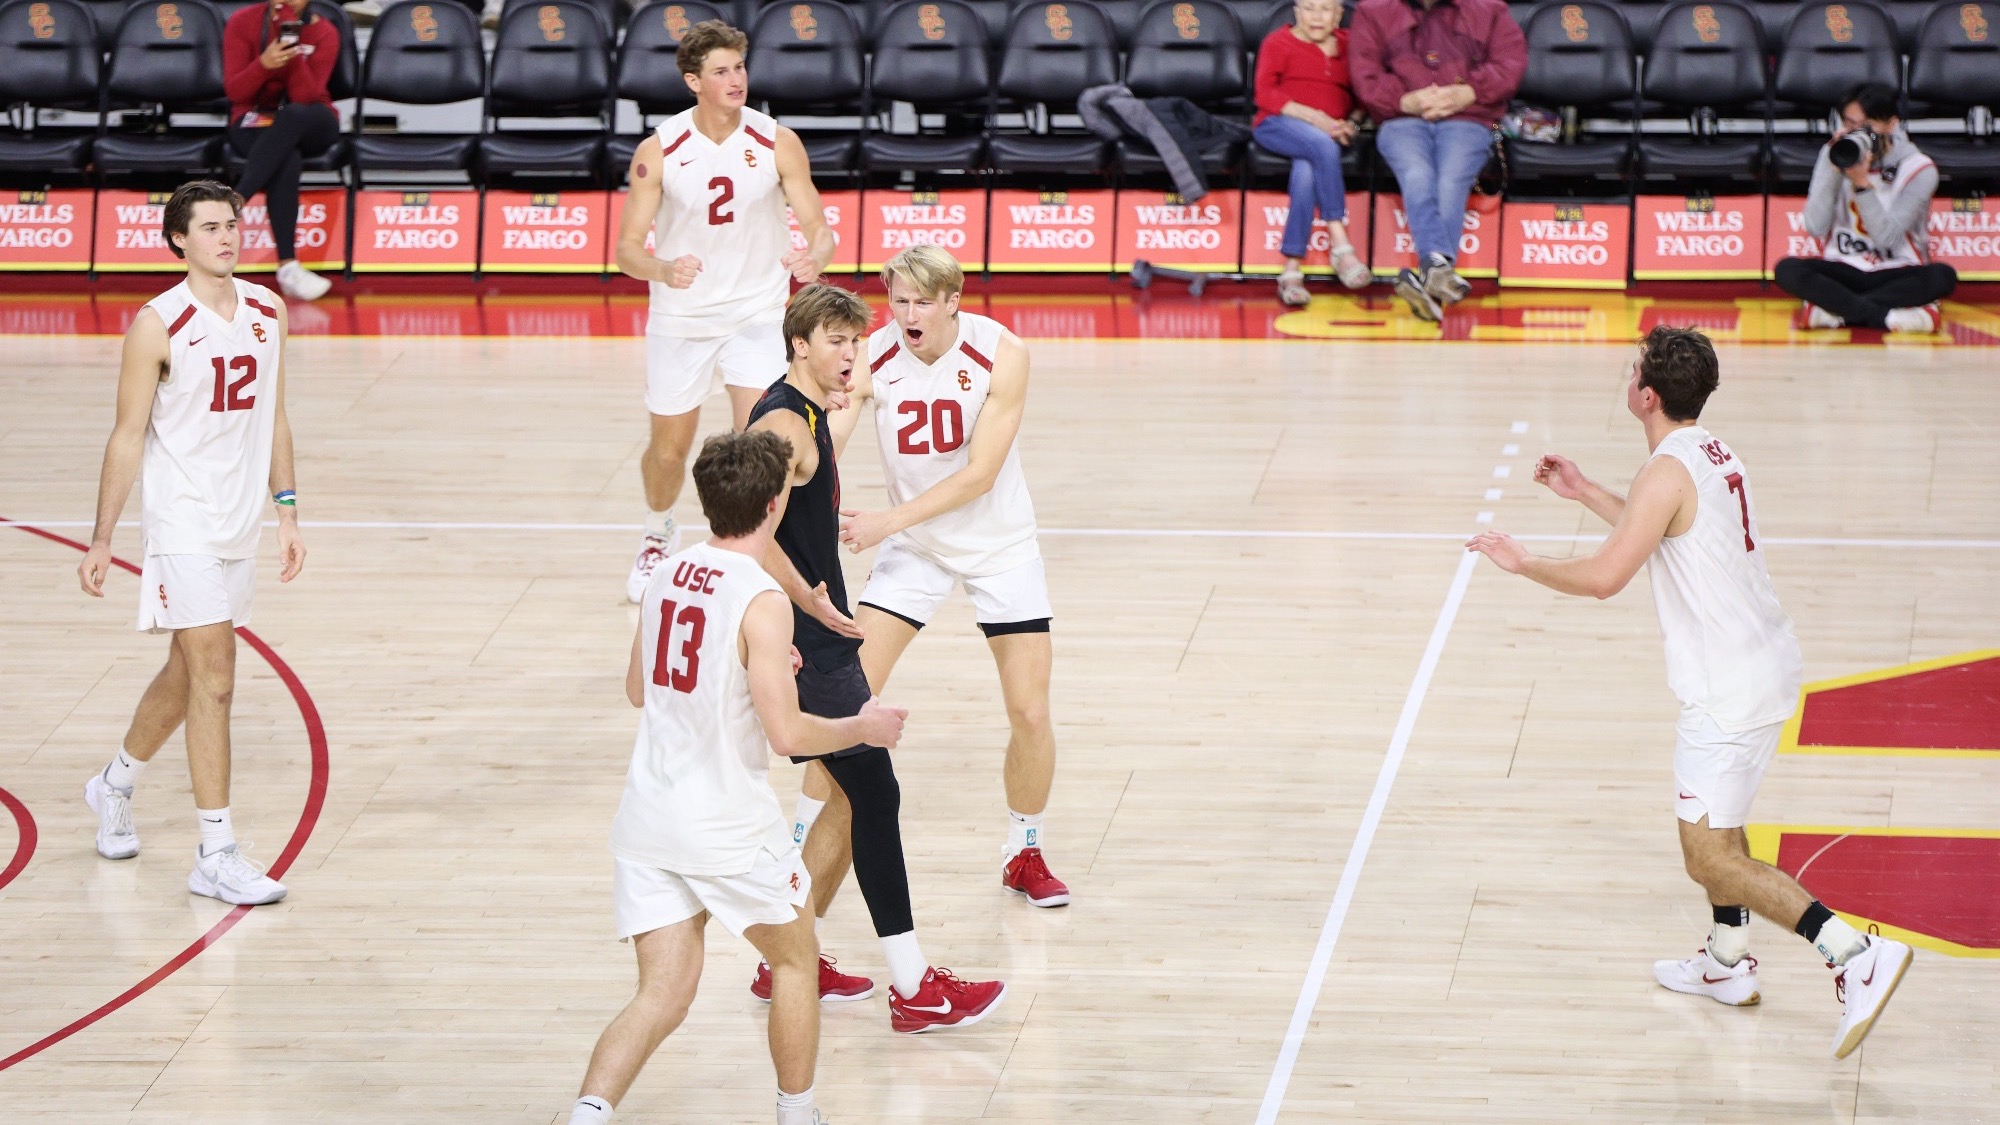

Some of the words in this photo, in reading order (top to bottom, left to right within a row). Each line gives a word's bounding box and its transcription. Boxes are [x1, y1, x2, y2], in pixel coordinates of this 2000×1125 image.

[745, 149, 757, 167] SC
[708, 176, 734, 225] 2
[373, 205, 460, 225] WELLS
[503, 206, 589, 226] WELLS
[881, 205, 967, 225] WELLS
[1008, 205, 1096, 225] WELLS
[1135, 205, 1221, 226] WELLS
[1653, 211, 1744, 232] WELLS
[242, 229, 327, 249] FAGO
[374, 229, 460, 249] FARGO
[503, 229, 589, 250] FARGO
[882, 229, 966, 249] FARGO
[1009, 228, 1096, 249] FARGO
[1135, 228, 1221, 250] FARGO
[1521, 220, 1609, 241] WELLS
[1522, 244, 1608, 265] FARGO
[1656, 235, 1744, 257] FARGO
[252, 322, 267, 343] SC
[210, 354, 257, 413] 12
[957, 369, 972, 391] SC
[897, 399, 964, 453] 20
[1724, 472, 1755, 552] 7
[672, 561, 725, 595] USC
[653, 598, 707, 694] 13
